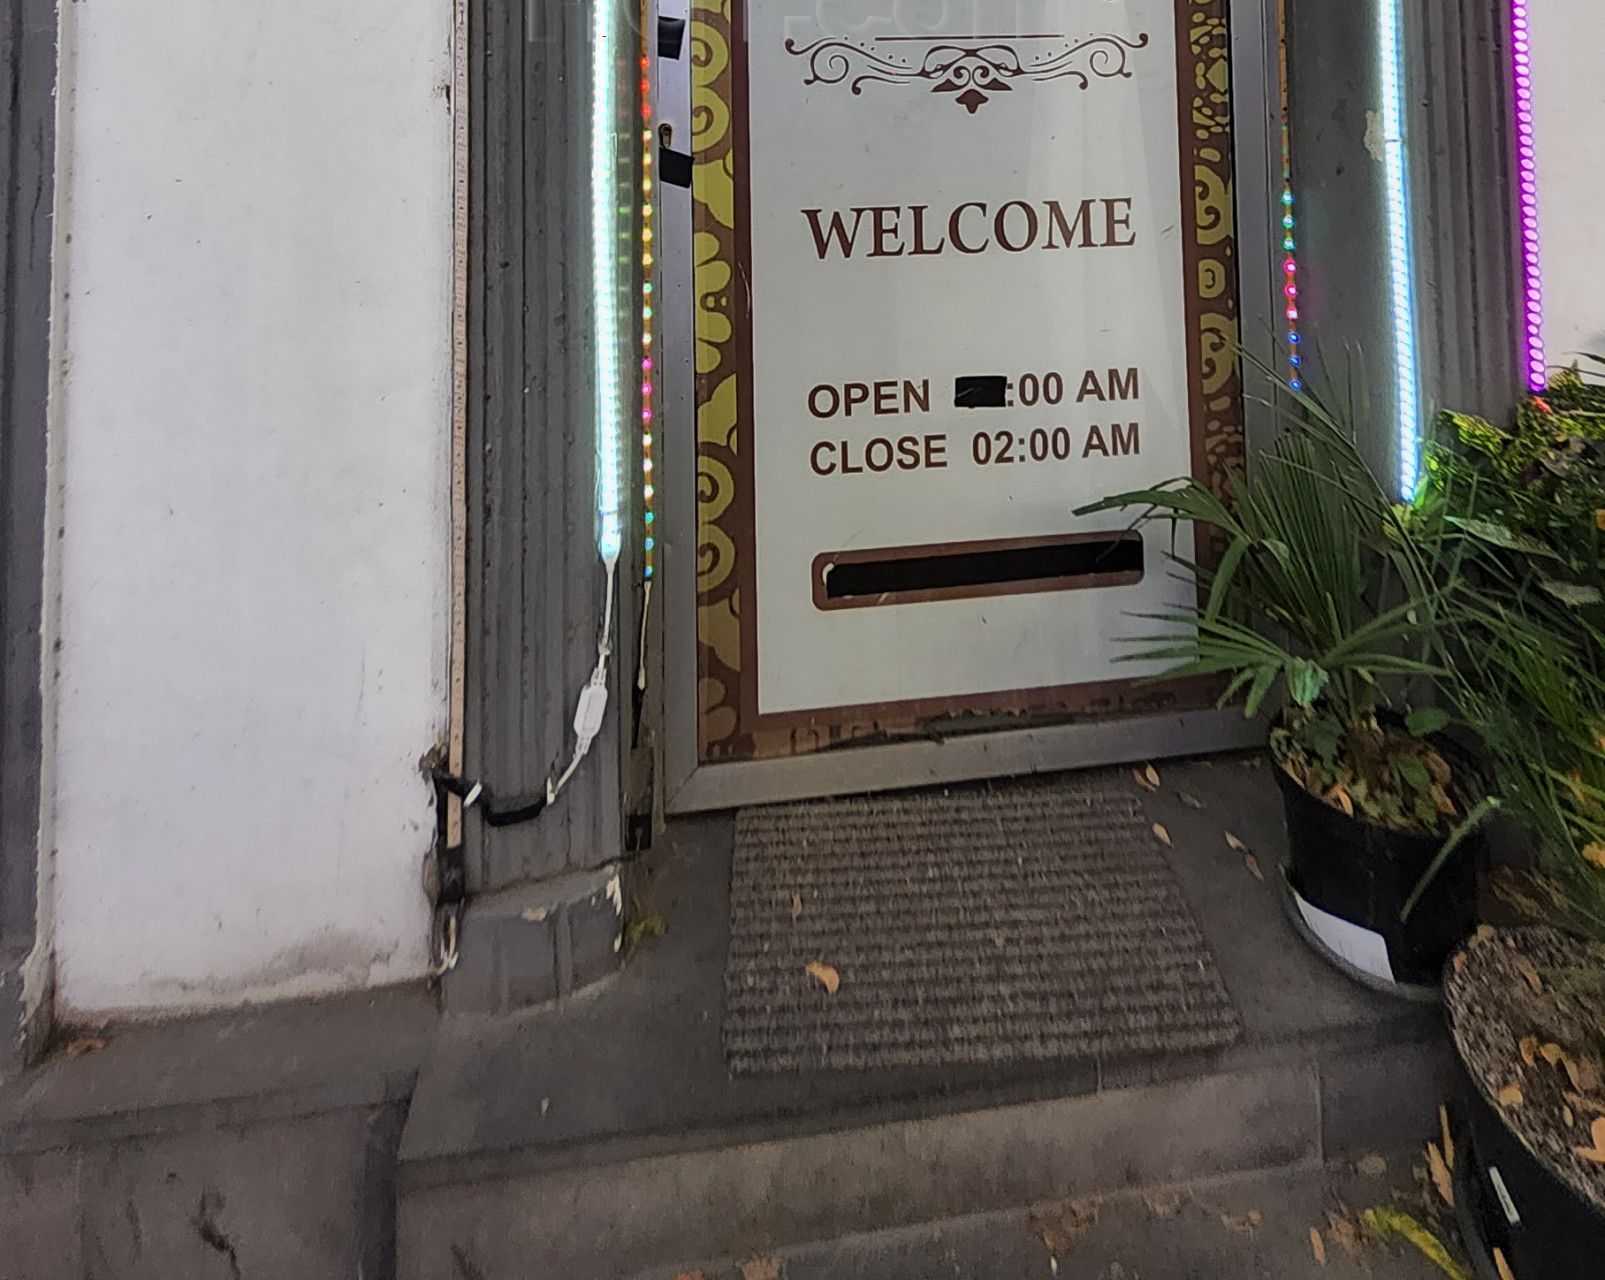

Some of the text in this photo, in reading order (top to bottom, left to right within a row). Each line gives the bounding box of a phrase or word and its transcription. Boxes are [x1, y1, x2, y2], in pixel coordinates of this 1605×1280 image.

[801, 197, 1136, 260] WELCOME
[807, 367, 1139, 418] OPEN :00 AM
[810, 422, 1140, 475] CLOSE 02:00 AM
